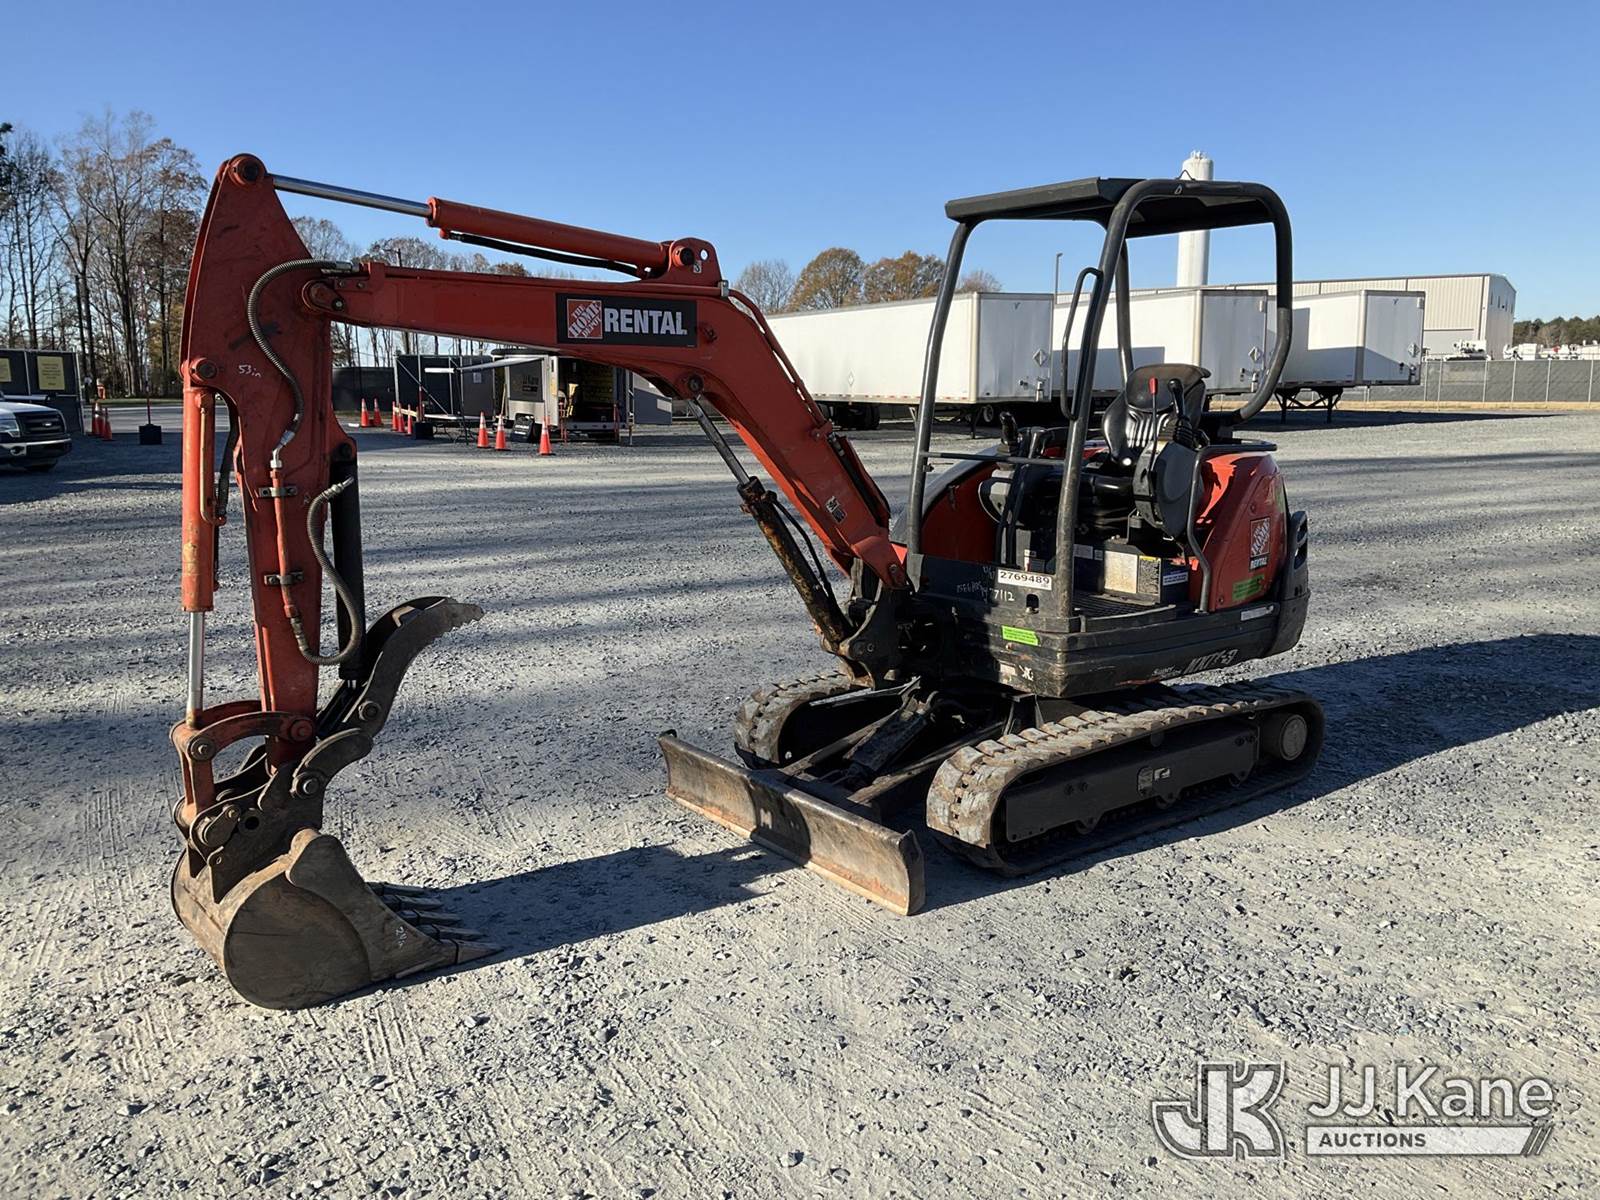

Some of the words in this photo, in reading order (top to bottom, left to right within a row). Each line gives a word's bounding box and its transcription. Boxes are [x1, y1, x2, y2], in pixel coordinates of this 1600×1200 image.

[568, 301, 602, 337] HOME
[604, 307, 688, 335] RENTAL
[1000, 571, 1050, 585] 2769489
